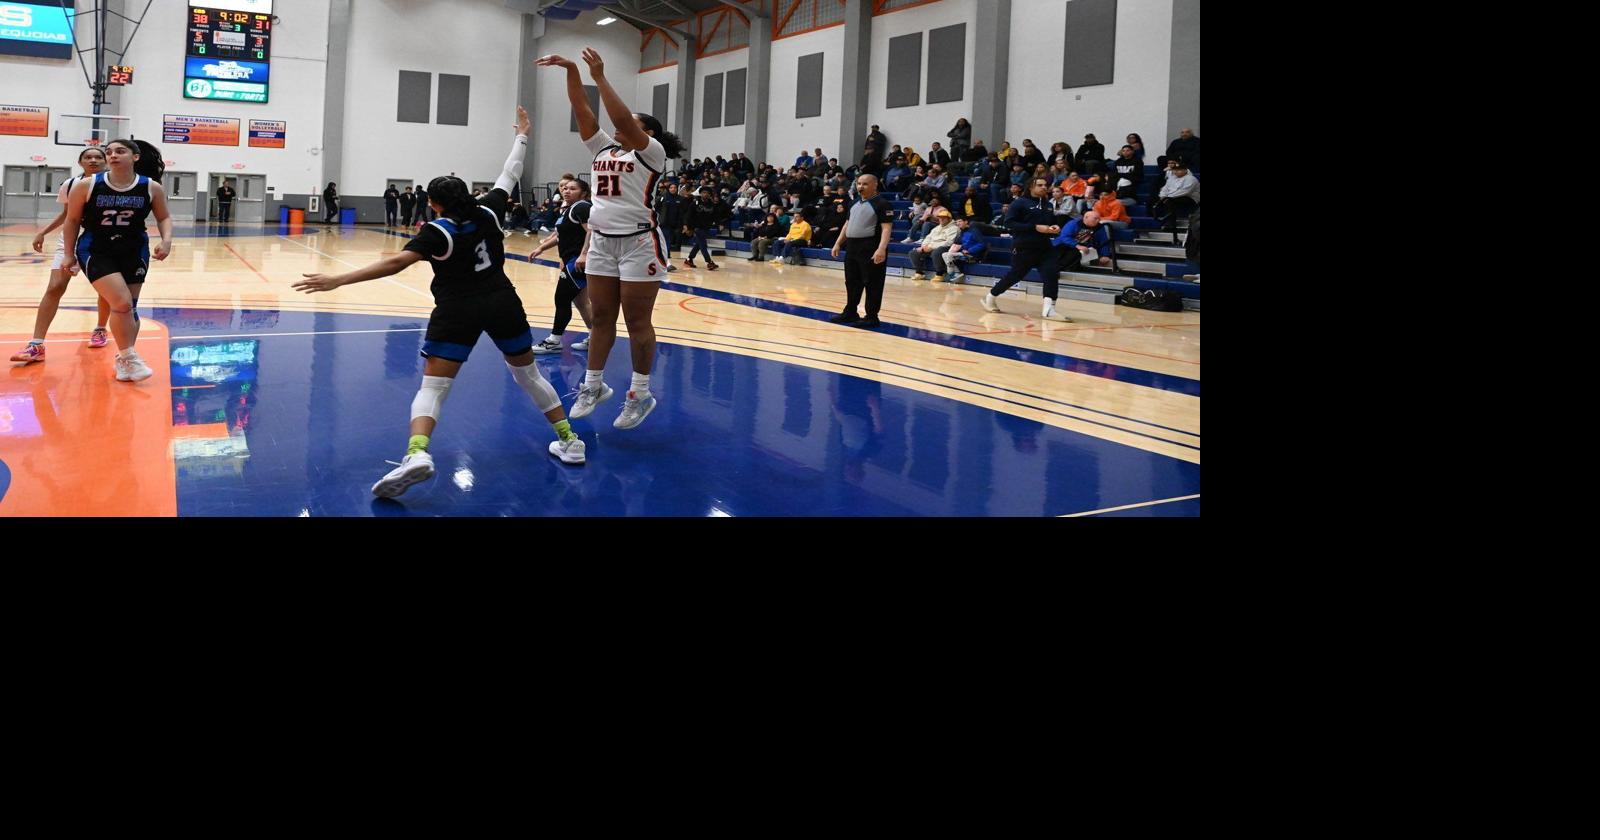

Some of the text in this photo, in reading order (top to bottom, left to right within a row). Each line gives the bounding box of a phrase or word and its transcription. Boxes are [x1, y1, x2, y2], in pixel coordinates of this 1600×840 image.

[193, 14, 208, 24] 38
[220, 11, 248, 23] 9:02
[234, 24, 241, 32] 3
[255, 20, 270, 30] 31
[199, 46, 206, 54] 0
[257, 51, 264, 59] 0
[110, 72, 129, 84] 22
[592, 160, 635, 173] GIANTS
[596, 174, 622, 197] 21
[101, 209, 134, 226] 22
[474, 239, 492, 272] 3
[647, 263, 657, 276] S
